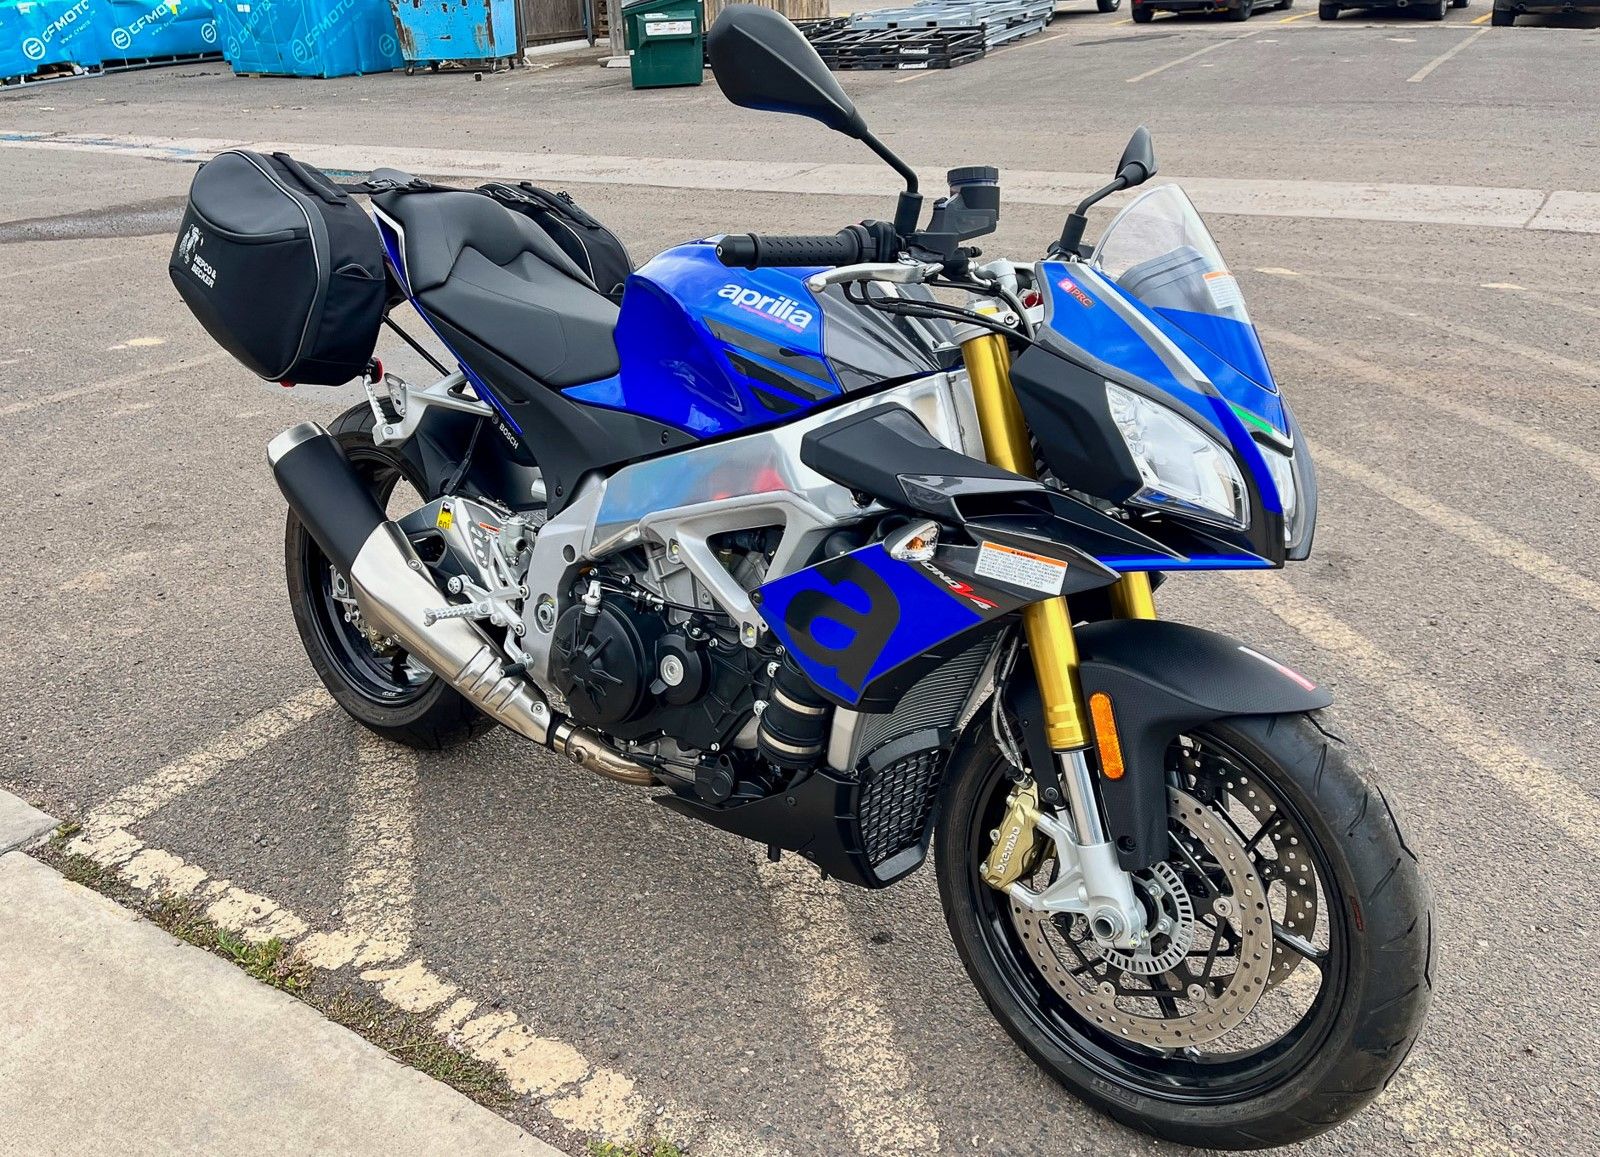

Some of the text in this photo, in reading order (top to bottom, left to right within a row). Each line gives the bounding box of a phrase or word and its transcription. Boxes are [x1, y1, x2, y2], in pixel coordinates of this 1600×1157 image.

[42, 0, 89, 43] CFMOTO
[128, 0, 179, 35] CFMO
[898, 61, 928, 69] Kawasaki
[899, 47, 929, 55] Kawasaki
[190, 263, 214, 289] BECKER
[193, 253, 217, 280] HEPCO &
[717, 283, 813, 329] aprilia
[499, 422, 519, 450] BOSCH
[438, 519, 451, 530] eni
[920, 560, 964, 589] ONO
[994, 826, 1020, 874] brembo
